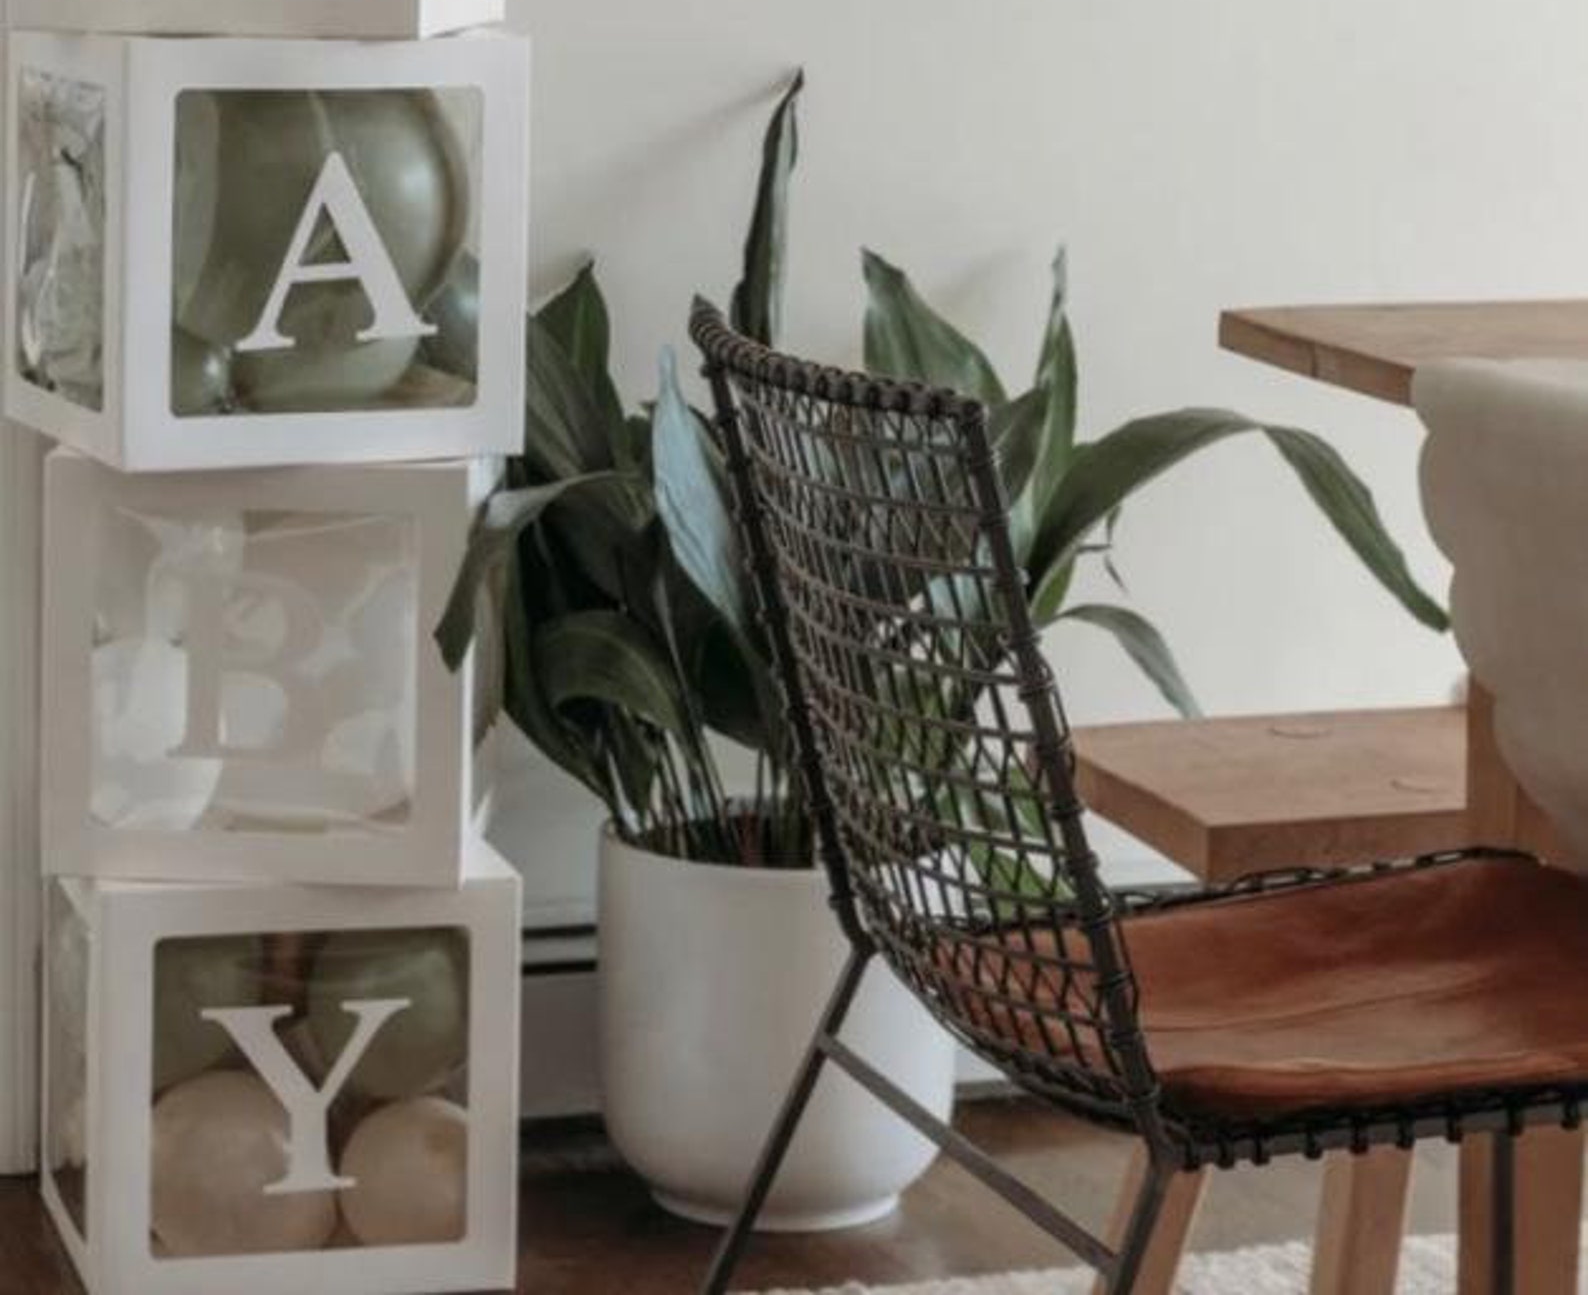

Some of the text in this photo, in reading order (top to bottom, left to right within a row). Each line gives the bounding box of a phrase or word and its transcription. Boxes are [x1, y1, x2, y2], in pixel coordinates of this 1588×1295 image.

[235, 151, 438, 352] A
[166, 569, 324, 760] B
[201, 998, 410, 1195] Y
